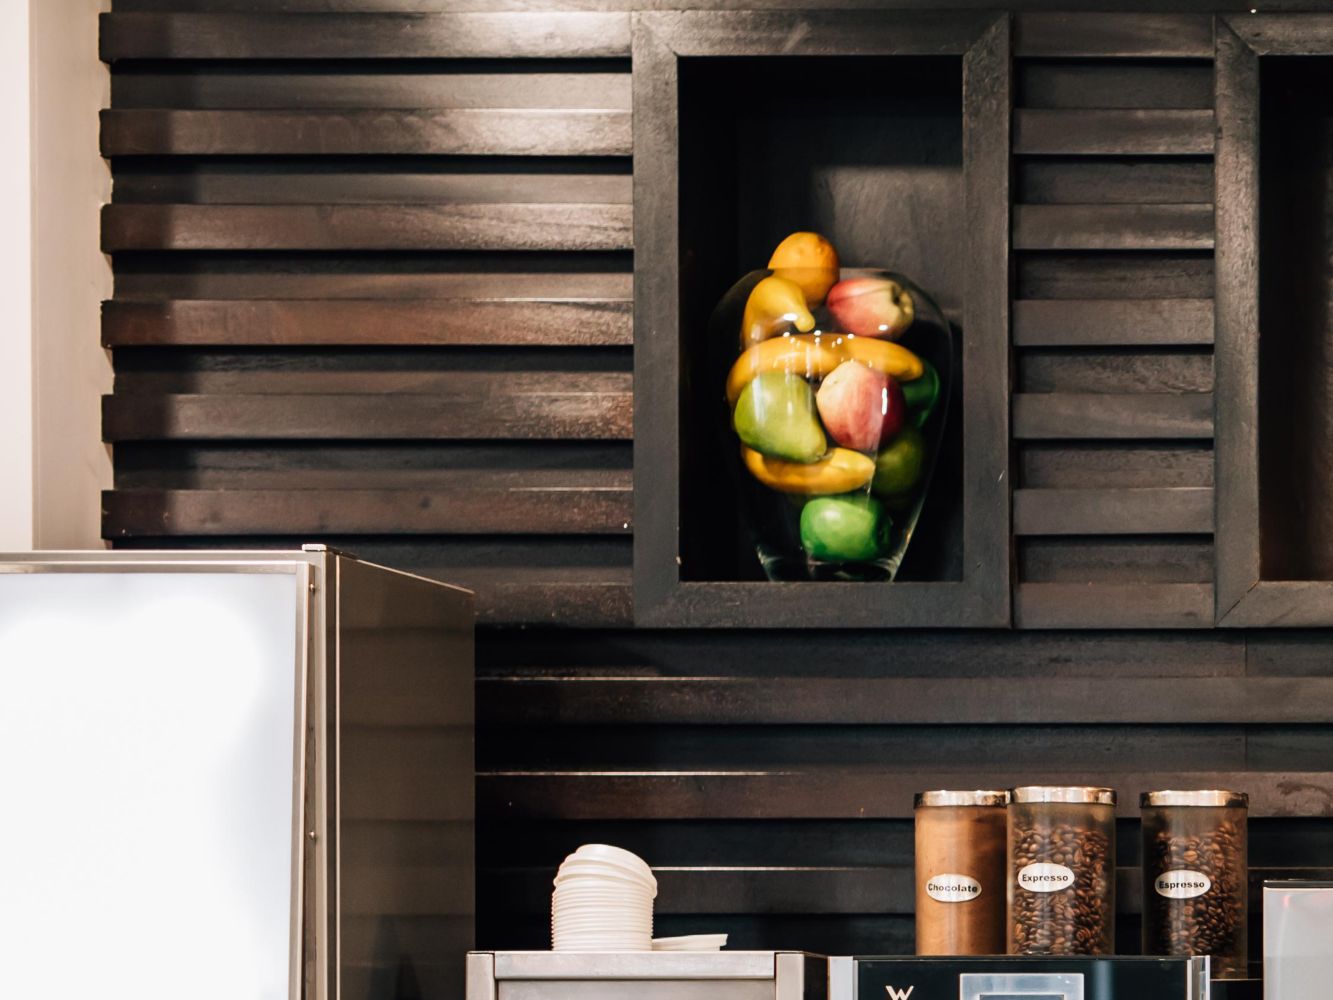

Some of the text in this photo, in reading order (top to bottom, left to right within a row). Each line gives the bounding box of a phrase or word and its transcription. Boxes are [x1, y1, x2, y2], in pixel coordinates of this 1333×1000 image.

[1022, 873, 1069, 884] Expresso
[928, 882, 978, 893] Chocolate
[1158, 880, 1205, 890] Espresso
